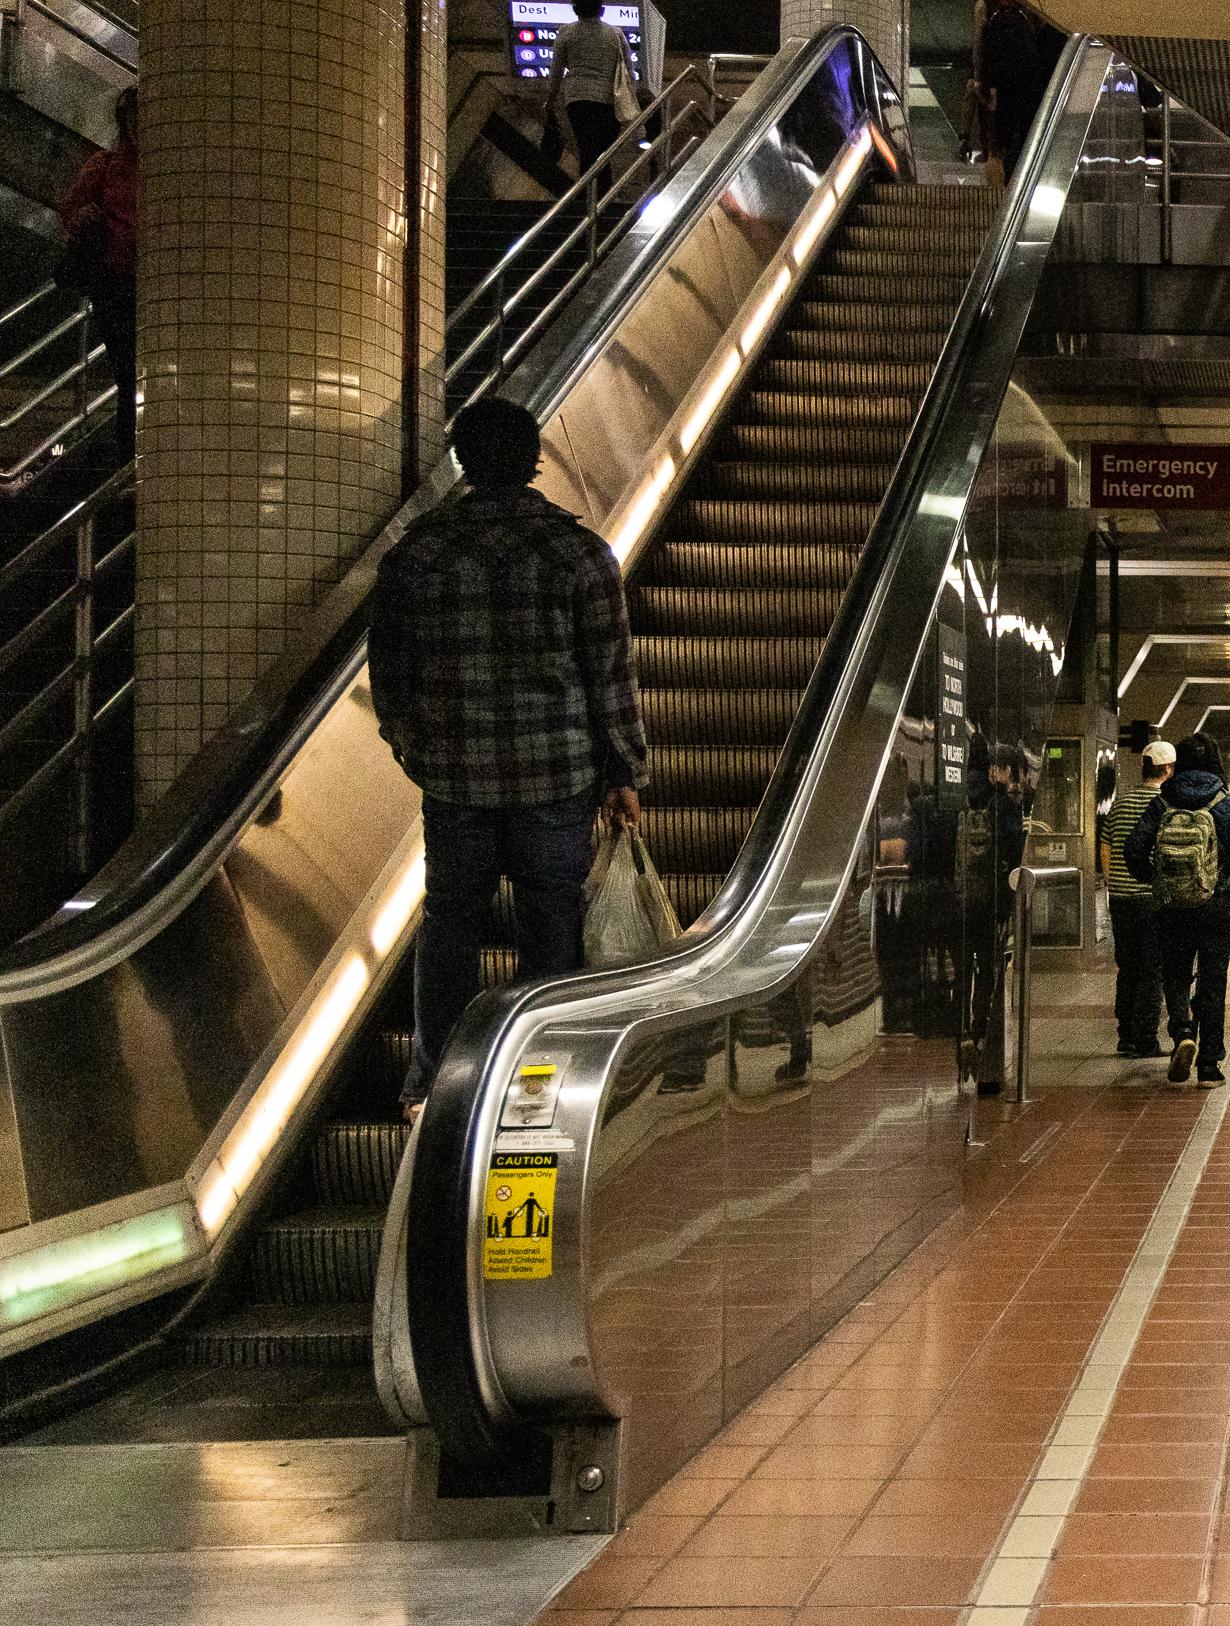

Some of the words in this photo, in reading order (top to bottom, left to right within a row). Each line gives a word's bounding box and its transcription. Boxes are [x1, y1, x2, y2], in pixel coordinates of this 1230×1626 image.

[519, 4, 547, 15] Dest
[537, 29, 560, 40] No
[630, 52, 639, 62] 6
[1102, 455, 1218, 479] Emergency
[1102, 478, 1195, 498] Intercom
[496, 1156, 552, 1166] CAUTION
[492, 1171, 534, 1179] Passengers
